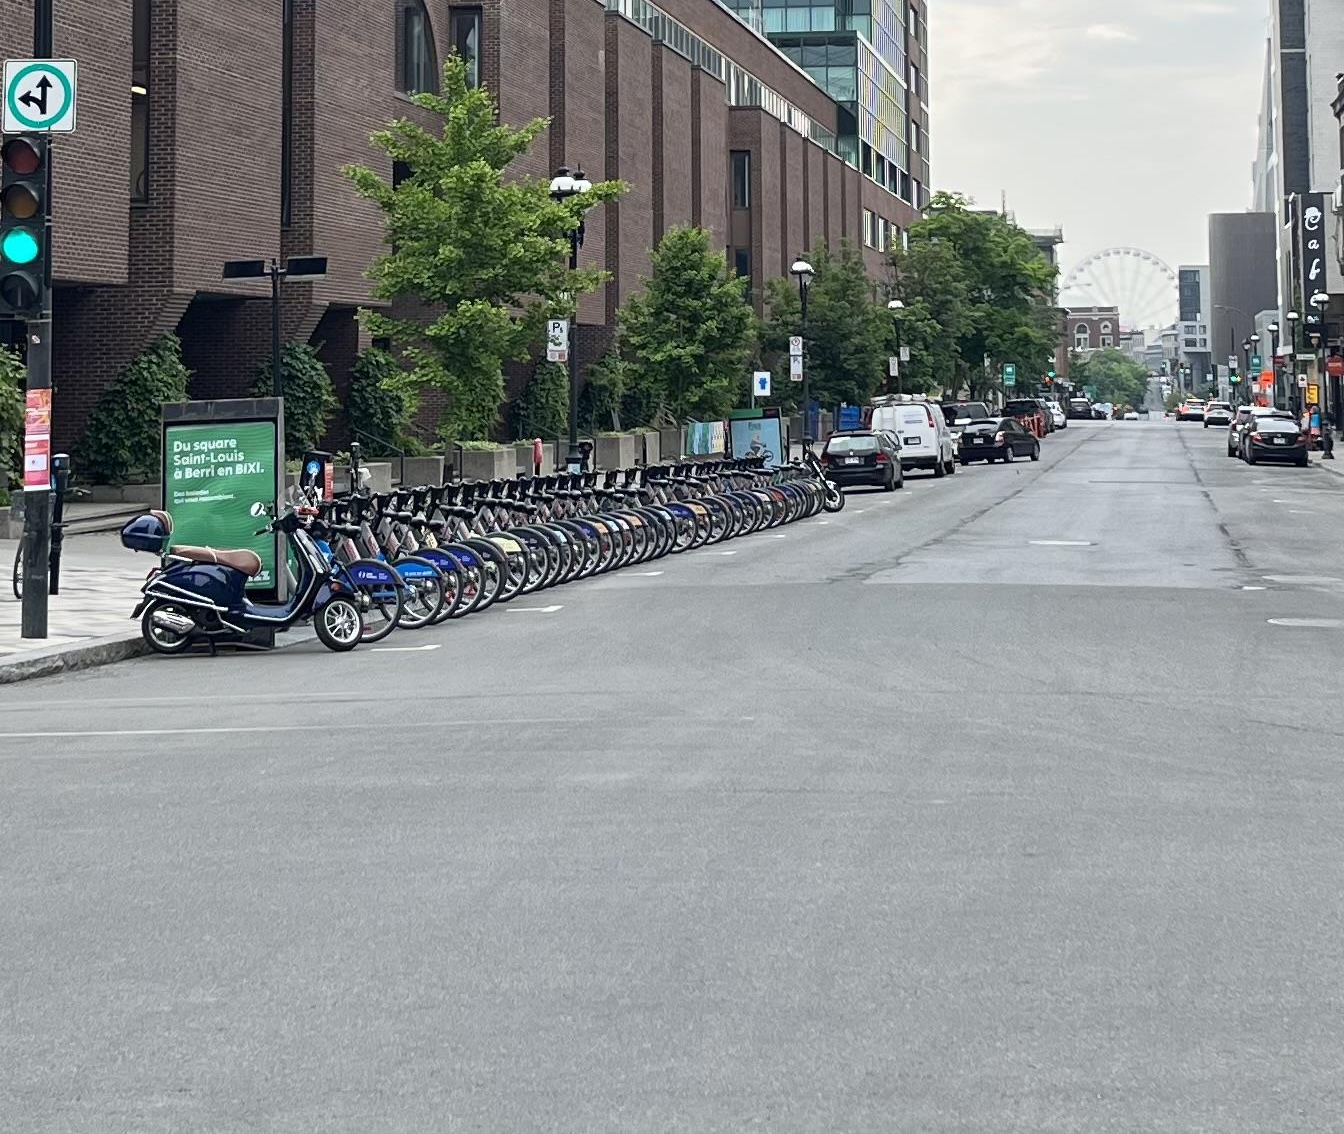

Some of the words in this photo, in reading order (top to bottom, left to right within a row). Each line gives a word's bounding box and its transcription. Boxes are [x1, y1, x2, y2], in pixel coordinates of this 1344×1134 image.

[173, 440, 191, 452] Du
[193, 438, 237, 453] square
[173, 449, 244, 466] Saint-Louis
[173, 467, 183, 480] à
[184, 464, 215, 479] Berri
[217, 466, 233, 476] en
[235, 461, 265, 475] BIXI.
